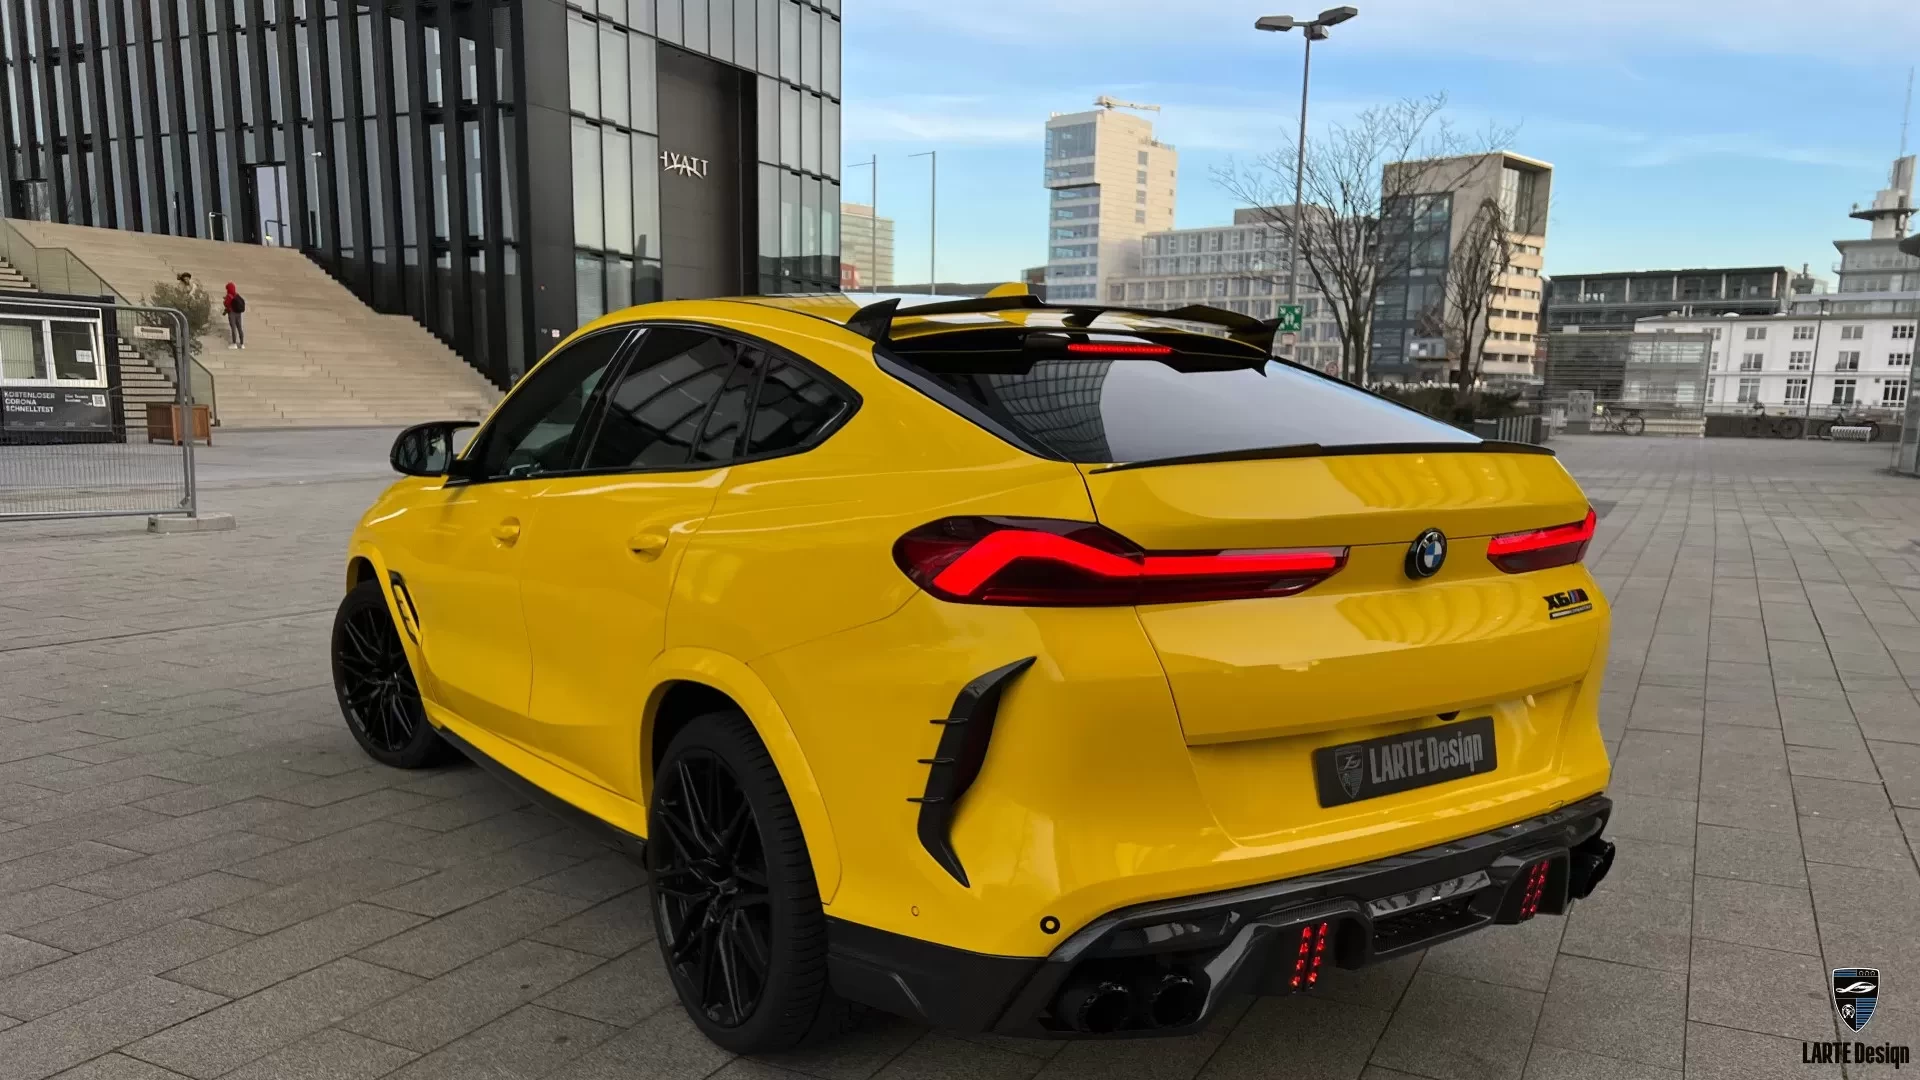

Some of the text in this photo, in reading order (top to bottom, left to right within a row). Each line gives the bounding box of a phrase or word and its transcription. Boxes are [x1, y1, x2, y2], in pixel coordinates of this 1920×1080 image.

[4, 391, 55, 399] KOSTENLOSER
[6, 405, 54, 413] SCHNELLTEST
[1369, 731, 1484, 784] LARTE Design
